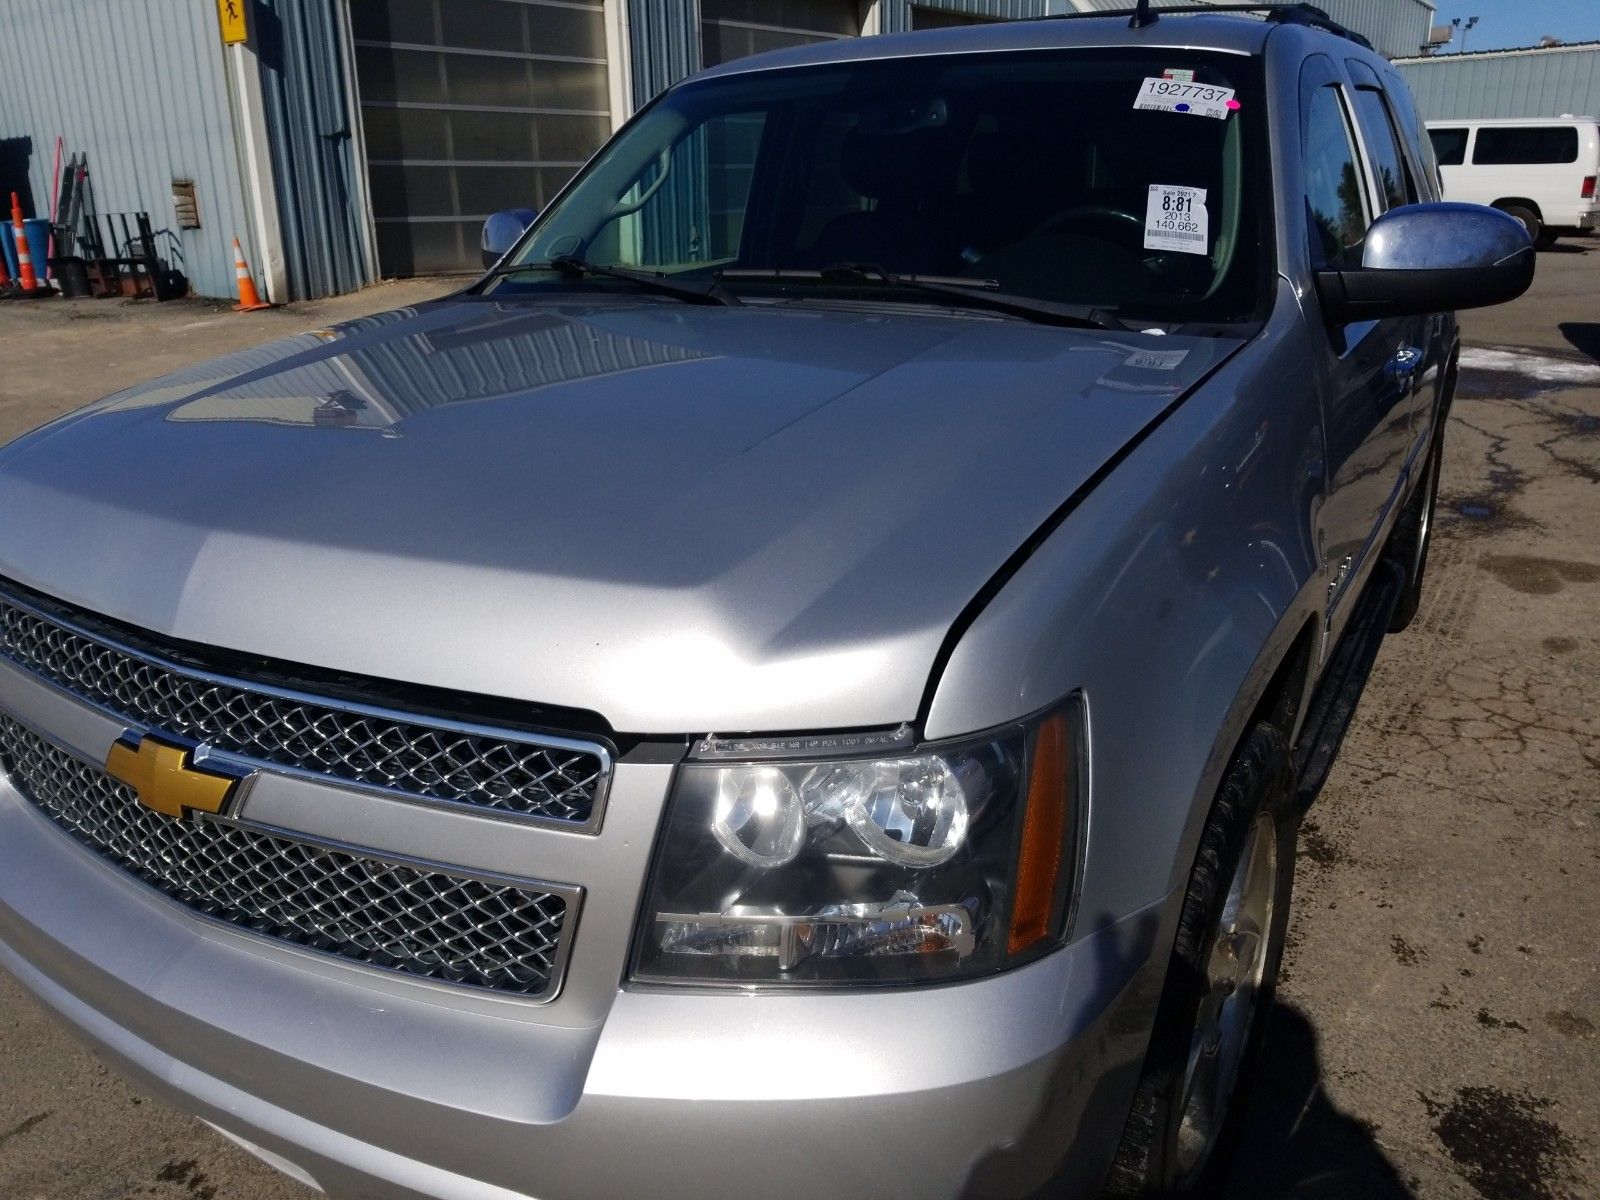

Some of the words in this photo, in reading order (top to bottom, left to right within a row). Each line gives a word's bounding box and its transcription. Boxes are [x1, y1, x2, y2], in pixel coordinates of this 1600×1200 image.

[1148, 81, 1227, 102] 1927737
[1162, 195, 1192, 213] 8:81
[1164, 211, 1191, 222] 2013
